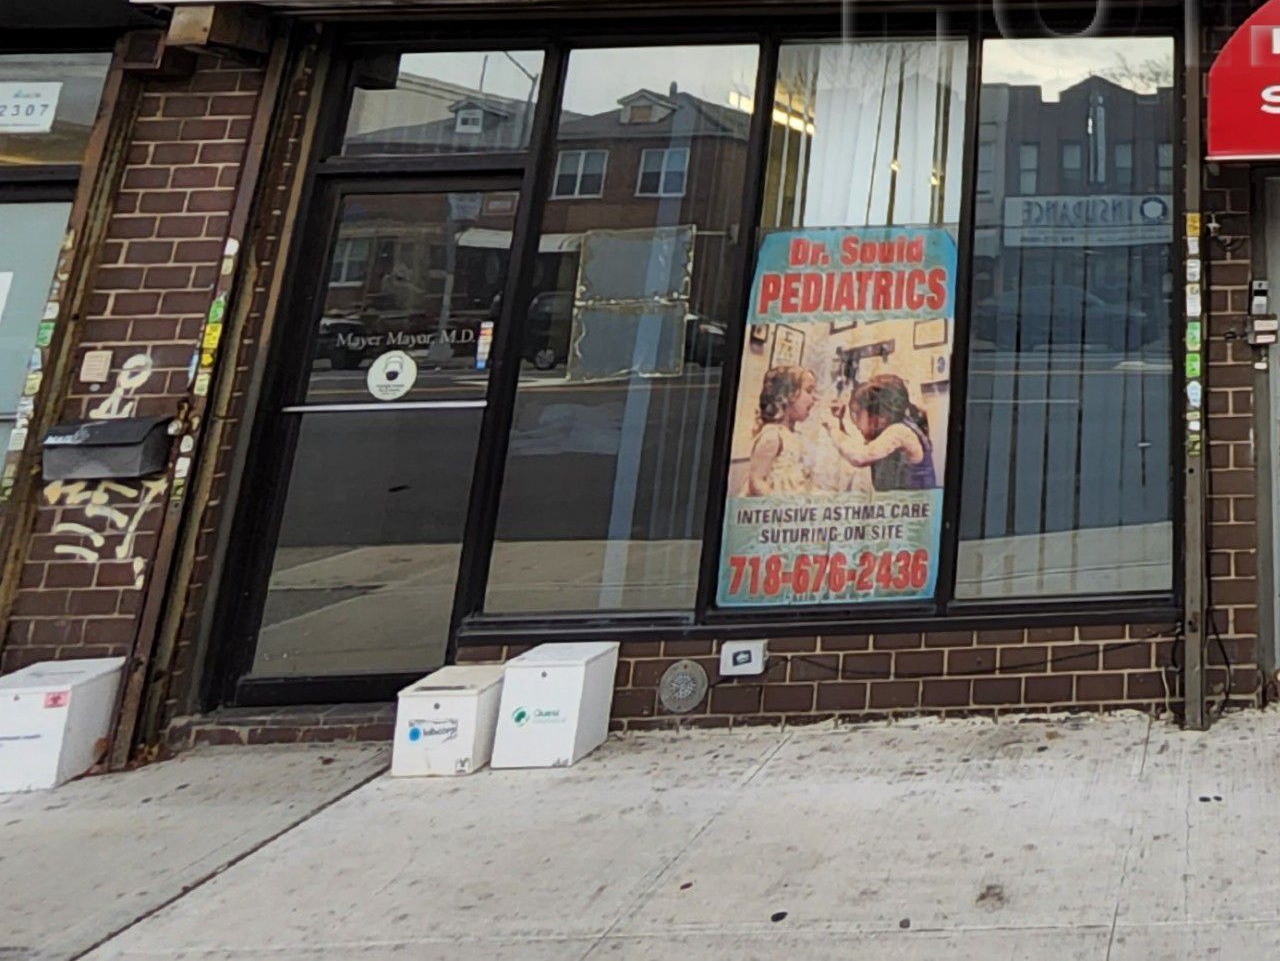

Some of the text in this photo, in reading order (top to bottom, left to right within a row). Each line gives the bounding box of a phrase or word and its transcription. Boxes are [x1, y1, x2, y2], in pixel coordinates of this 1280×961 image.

[788, 236, 925, 266] Dr. Souid
[757, 269, 947, 315] PEDIATRICS
[439, 329, 475, 343] M.D.
[737, 502, 930, 523] INTENSIVE ASTHMA CARE
[760, 524, 903, 543] SUTURING ON SITE
[728, 549, 929, 597] 718-676-2436
